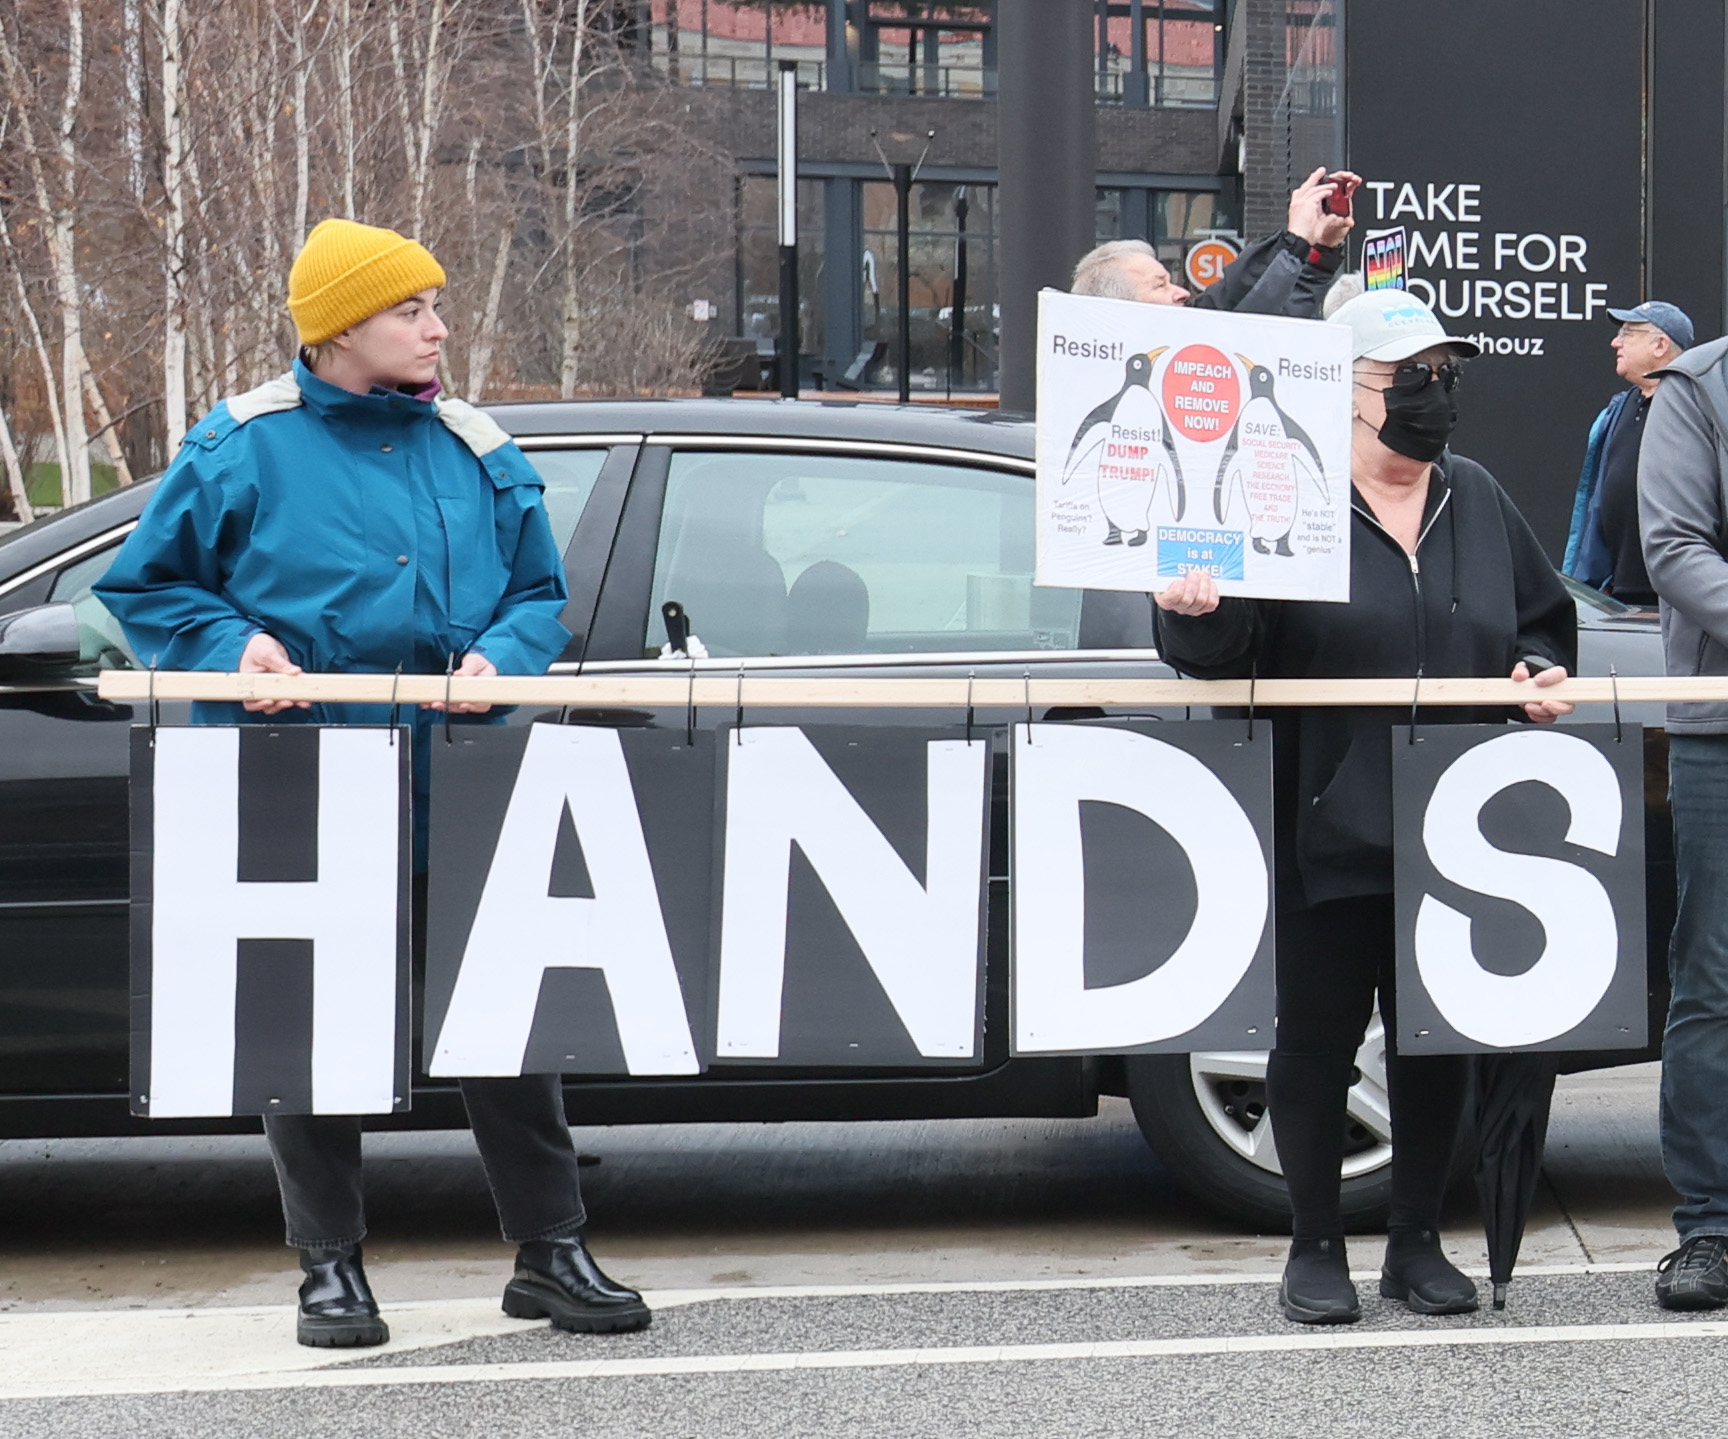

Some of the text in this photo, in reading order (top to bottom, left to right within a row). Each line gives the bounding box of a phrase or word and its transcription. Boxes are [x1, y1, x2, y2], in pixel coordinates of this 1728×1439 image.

[1366, 182, 1481, 222] TAKE
[1495, 233, 1588, 273] FOR
[1407, 279, 1608, 320] OURSELF
[1053, 335, 1124, 361] Resist!
[1173, 361, 1231, 379] IMPEACH
[1278, 358, 1342, 382] Resist!
[1190, 381, 1215, 393] AND
[1175, 396, 1229, 413] REMOVE
[1184, 415, 1220, 431] NOW!
[1245, 422, 1281, 437] SAVE:
[1111, 425, 1161, 442] Resist!
[1107, 444, 1149, 460] DUMP
[1242, 438, 1302, 450] SOCIAL SECURITY
[1100, 465, 1155, 482] TRUMP!
[1250, 491, 1268, 501] FREE
[1251, 513, 1265, 521] THE
[1159, 529, 1242, 546] DEMOCRACY
[1187, 548, 1214, 561] is at
[151, 722, 1622, 1117] HANDS
